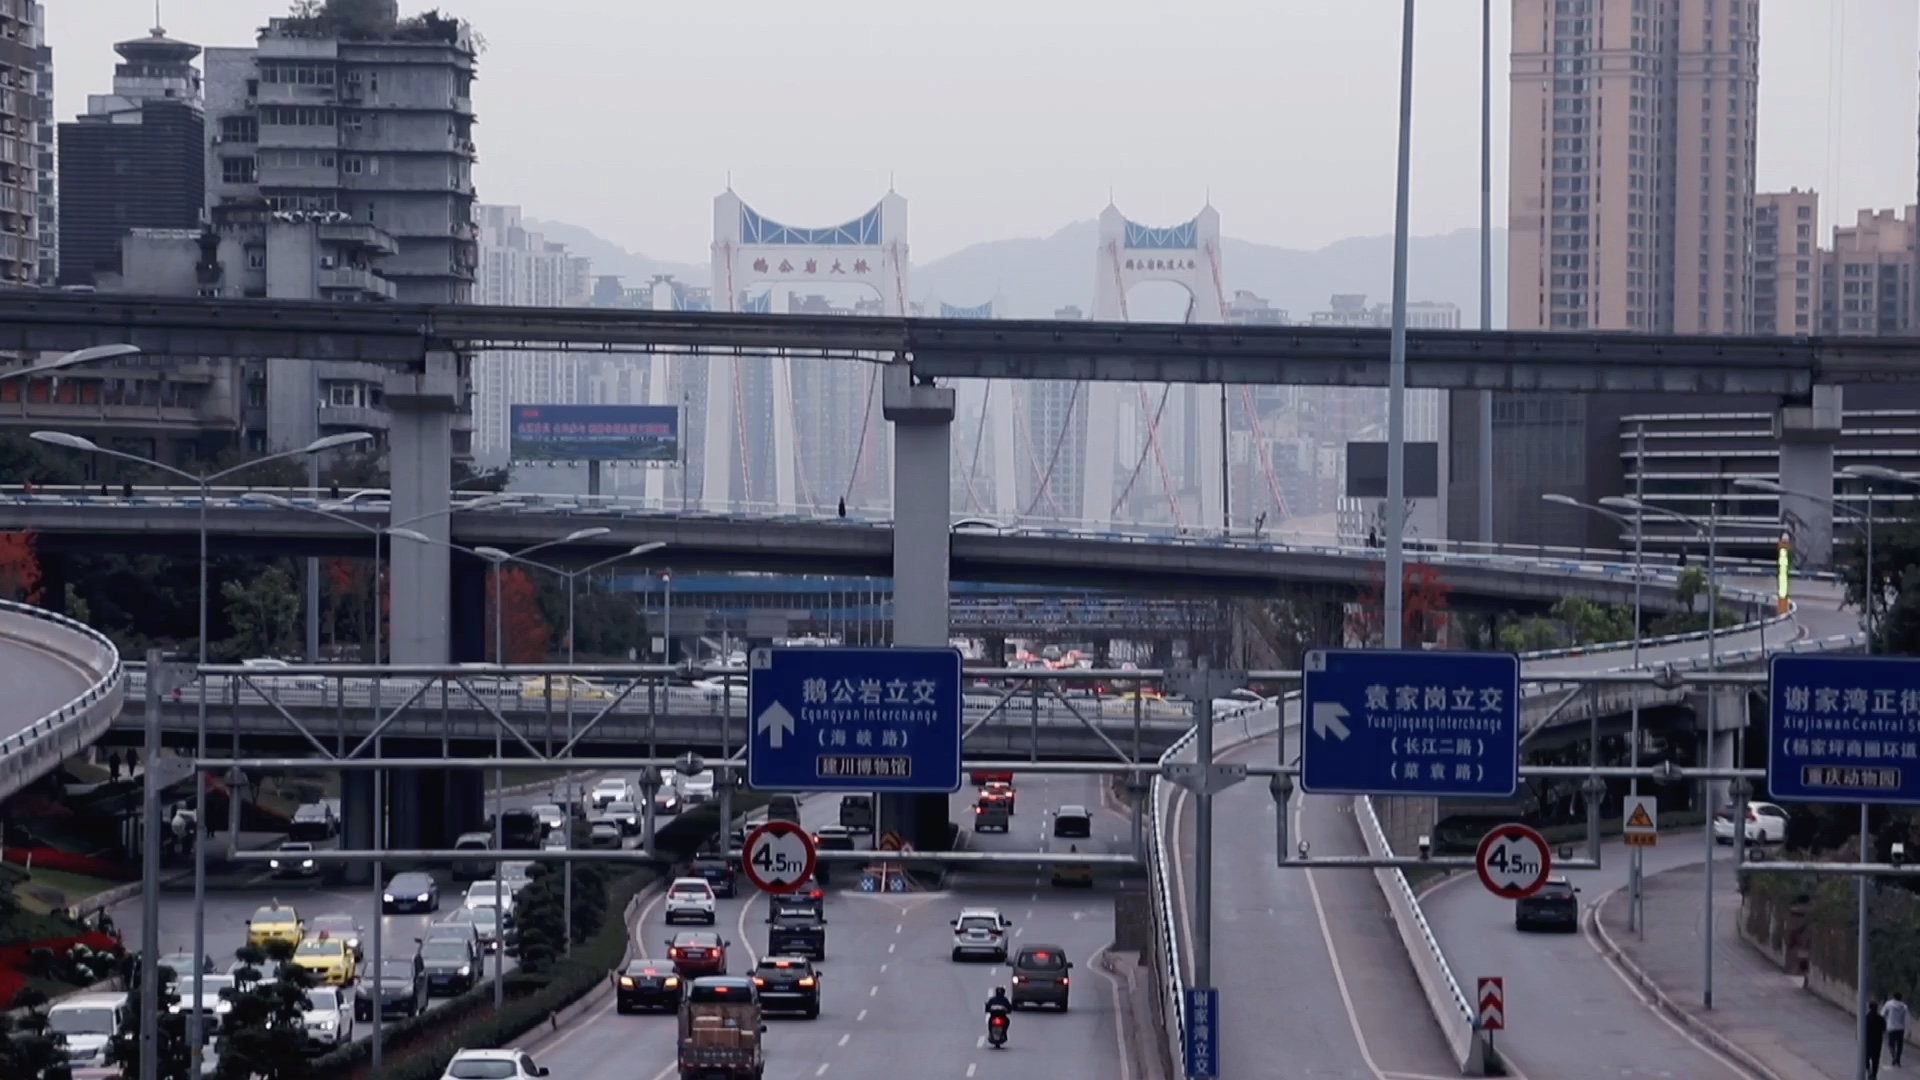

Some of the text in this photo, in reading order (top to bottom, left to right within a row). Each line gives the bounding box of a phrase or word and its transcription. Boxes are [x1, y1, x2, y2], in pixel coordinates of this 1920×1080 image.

[803, 677, 936, 704] 鹅公岩立交
[1364, 684, 1504, 712] 袁家岗立交
[1784, 685, 1920, 715] 谢家湾正街
[801, 707, 938, 725] Egongyan Interchange
[1366, 714, 1502, 734] Yuanjiagang Interchange
[1783, 715, 1850, 733] Xiejiawan
[1852, 717, 1904, 732] Central
[822, 757, 907, 776] 建川博物馆
[1808, 767, 1895, 788] 重庆动物园
[752, 842, 803, 873] 4.5m
[1487, 843, 1539, 874] 4.5m
